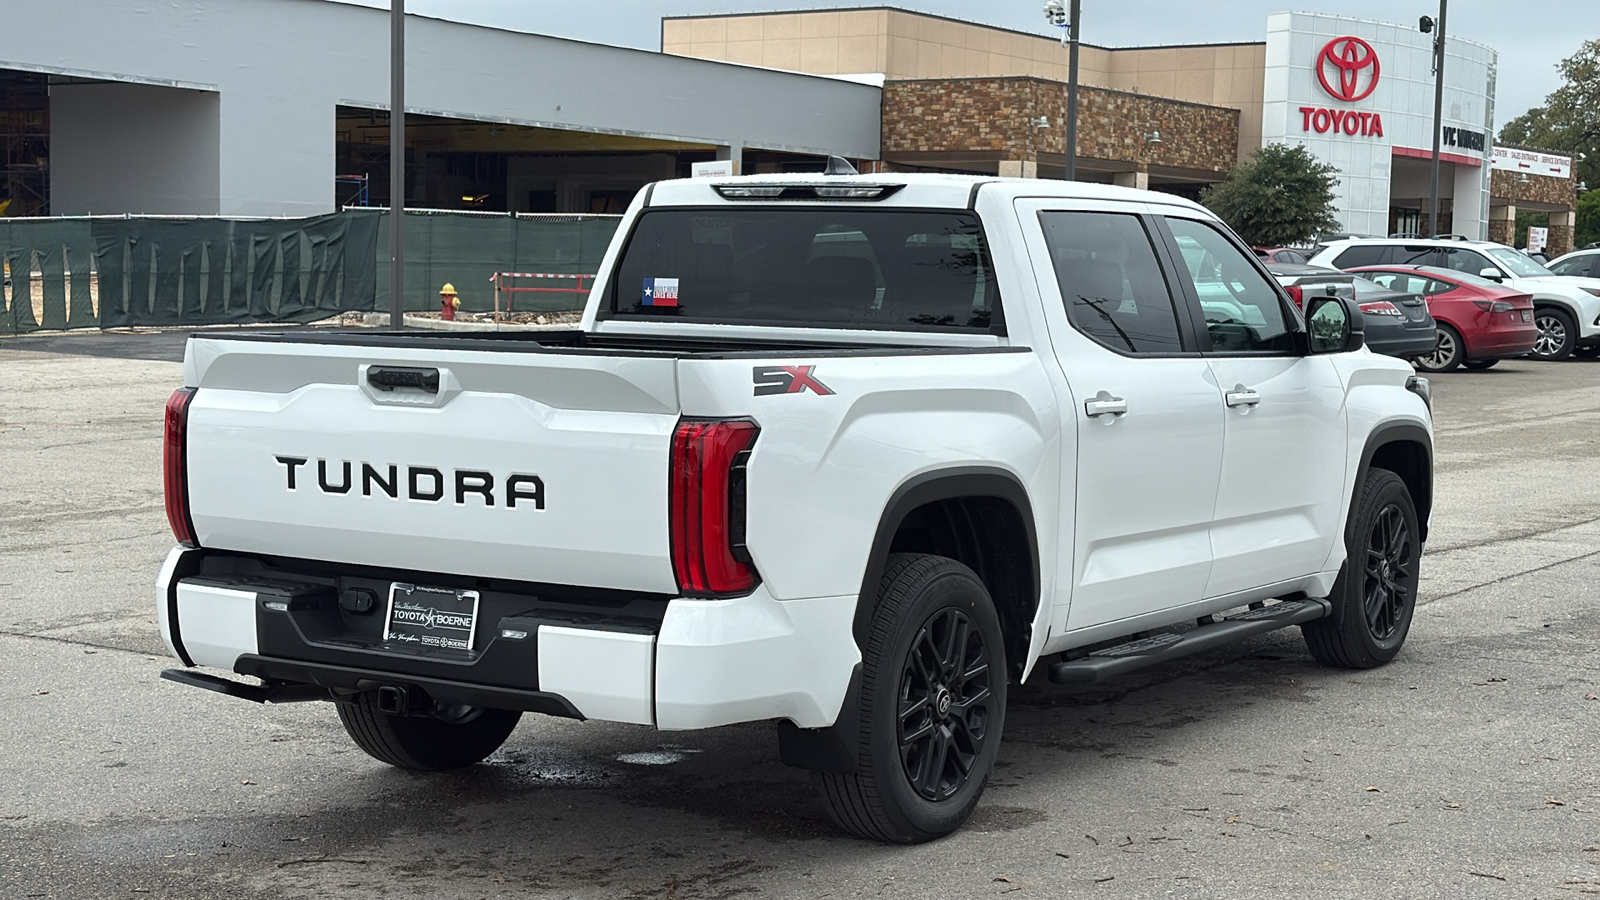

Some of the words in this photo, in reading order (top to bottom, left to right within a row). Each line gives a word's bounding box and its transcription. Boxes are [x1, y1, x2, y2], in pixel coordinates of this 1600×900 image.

[1299, 106, 1384, 138] TOYOTA
[1443, 126, 1457, 147] VIC
[1511, 151, 1521, 160] SALES
[1521, 153, 1538, 163] ENTRANCE
[1541, 155, 1554, 164] SERVICE
[1554, 157, 1570, 167] ENTRANCE
[274, 455, 546, 512] TUNDRA
[394, 610, 425, 622] TOYOTA
[436, 615, 472, 627] BOERNE
[421, 637, 440, 645] TOYOTA
[448, 640, 468, 648] BOERNE
